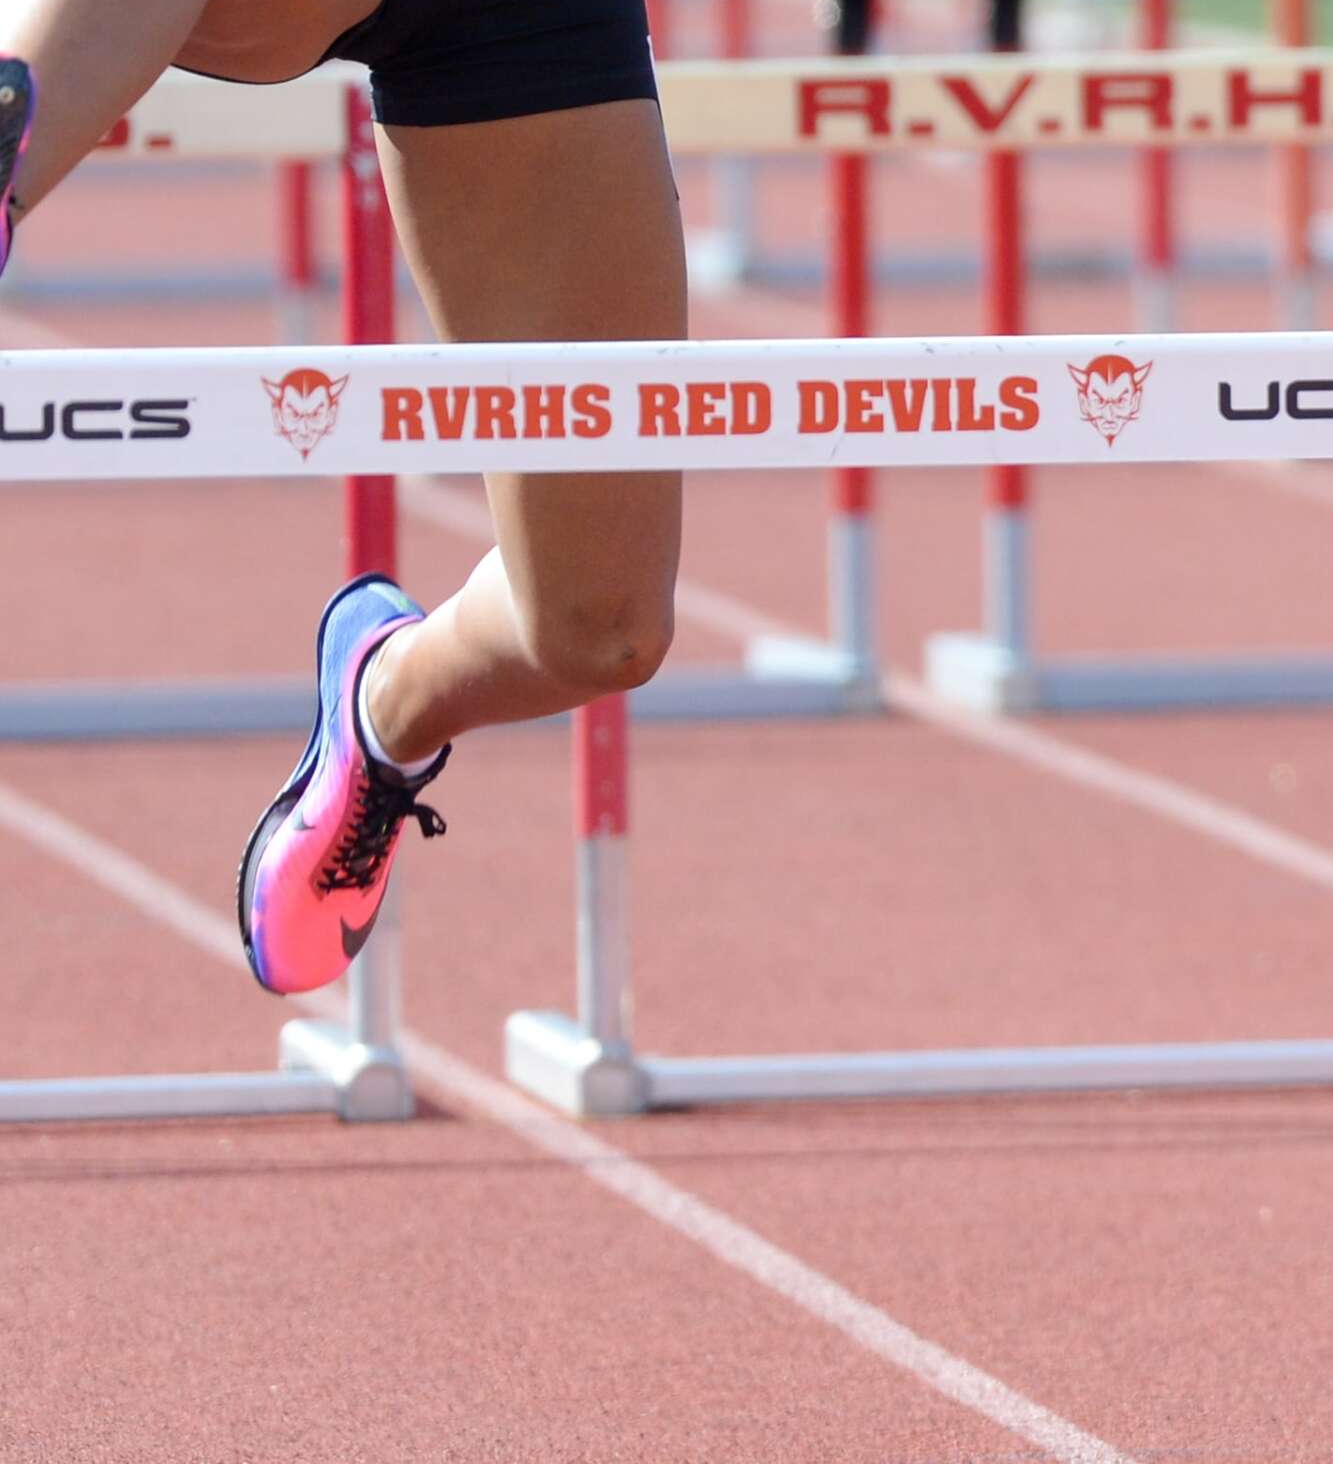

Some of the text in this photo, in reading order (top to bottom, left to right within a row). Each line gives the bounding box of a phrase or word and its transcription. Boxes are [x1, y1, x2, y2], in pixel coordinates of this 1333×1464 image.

[0, 399, 191, 441] UCS
[380, 383, 612, 441] RVRHS
[637, 381, 772, 438] RED
[796, 375, 1041, 435] DEVILS
